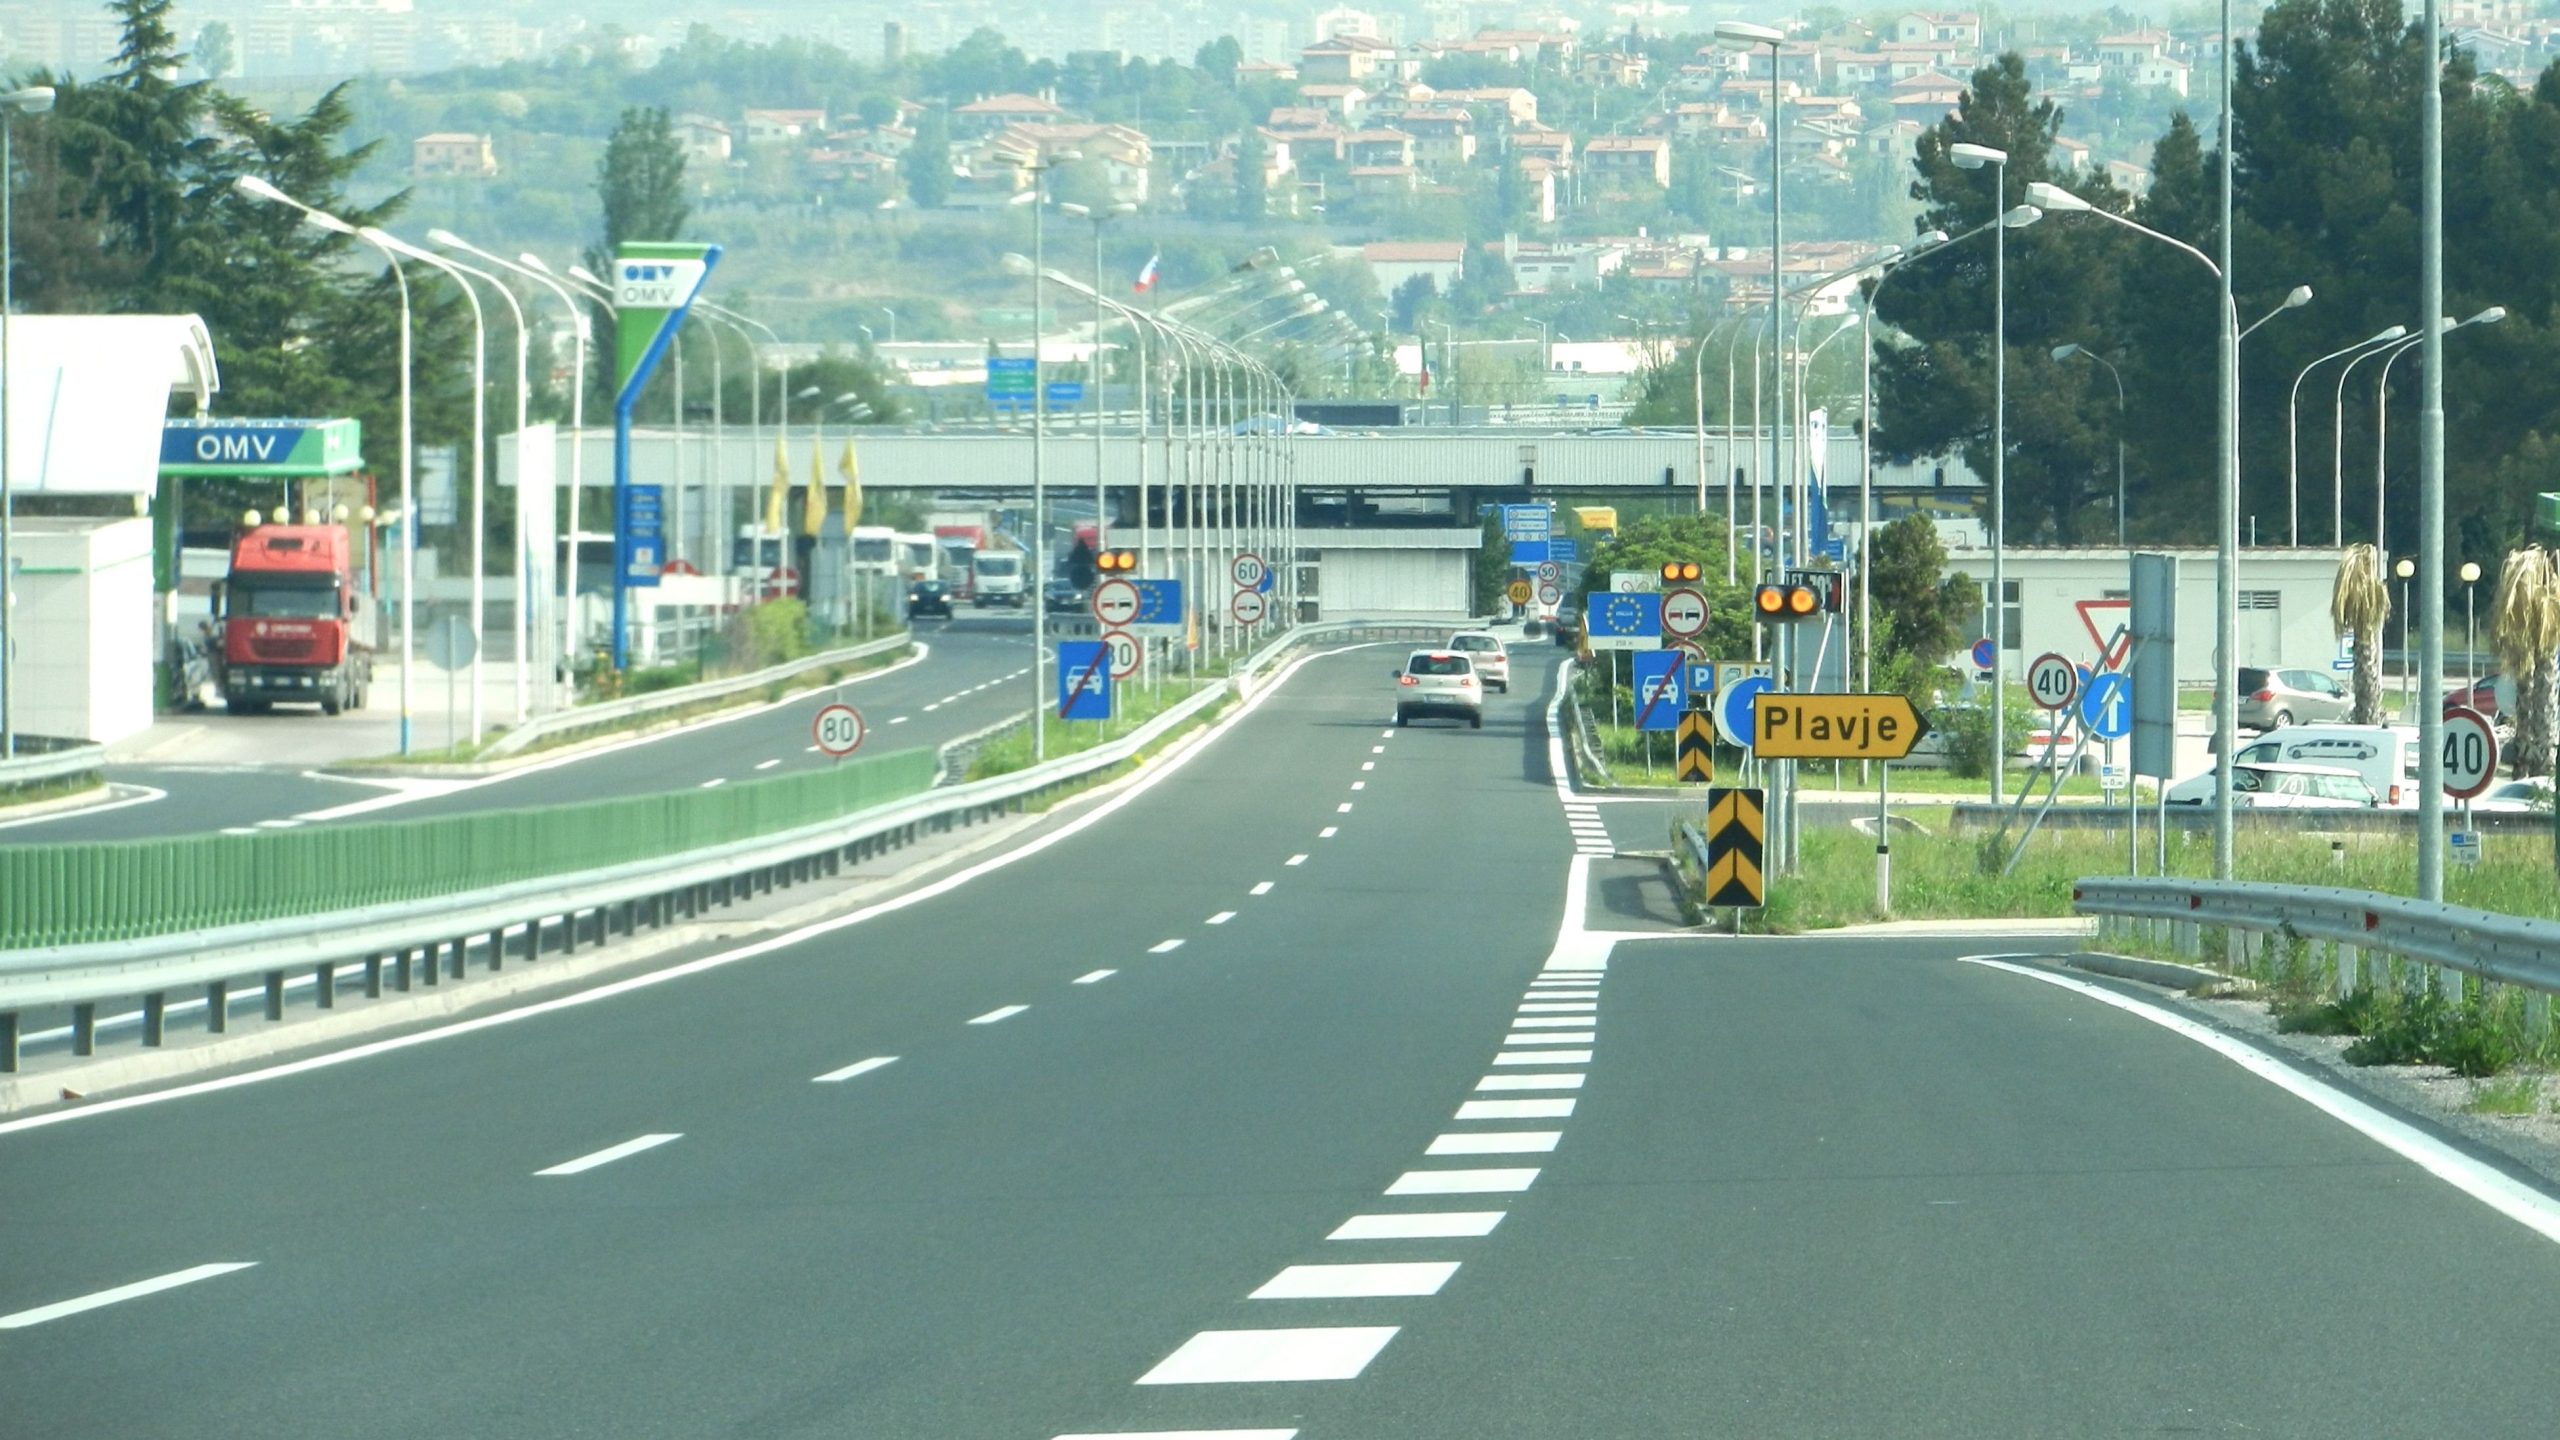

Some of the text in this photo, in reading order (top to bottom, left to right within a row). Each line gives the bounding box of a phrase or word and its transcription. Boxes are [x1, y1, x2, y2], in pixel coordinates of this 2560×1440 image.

[622, 287, 675, 302] OMV
[196, 434, 276, 461] OMV
[1238, 563, 1258, 580] 60
[1541, 567, 1555, 577] 50
[1512, 585, 1528, 599] 40
[1695, 667, 1710, 688] P
[2037, 669, 2067, 696] 40
[823, 717, 855, 742] 80
[1764, 706, 1898, 750] Plavje
[2443, 732, 2482, 775] 40
